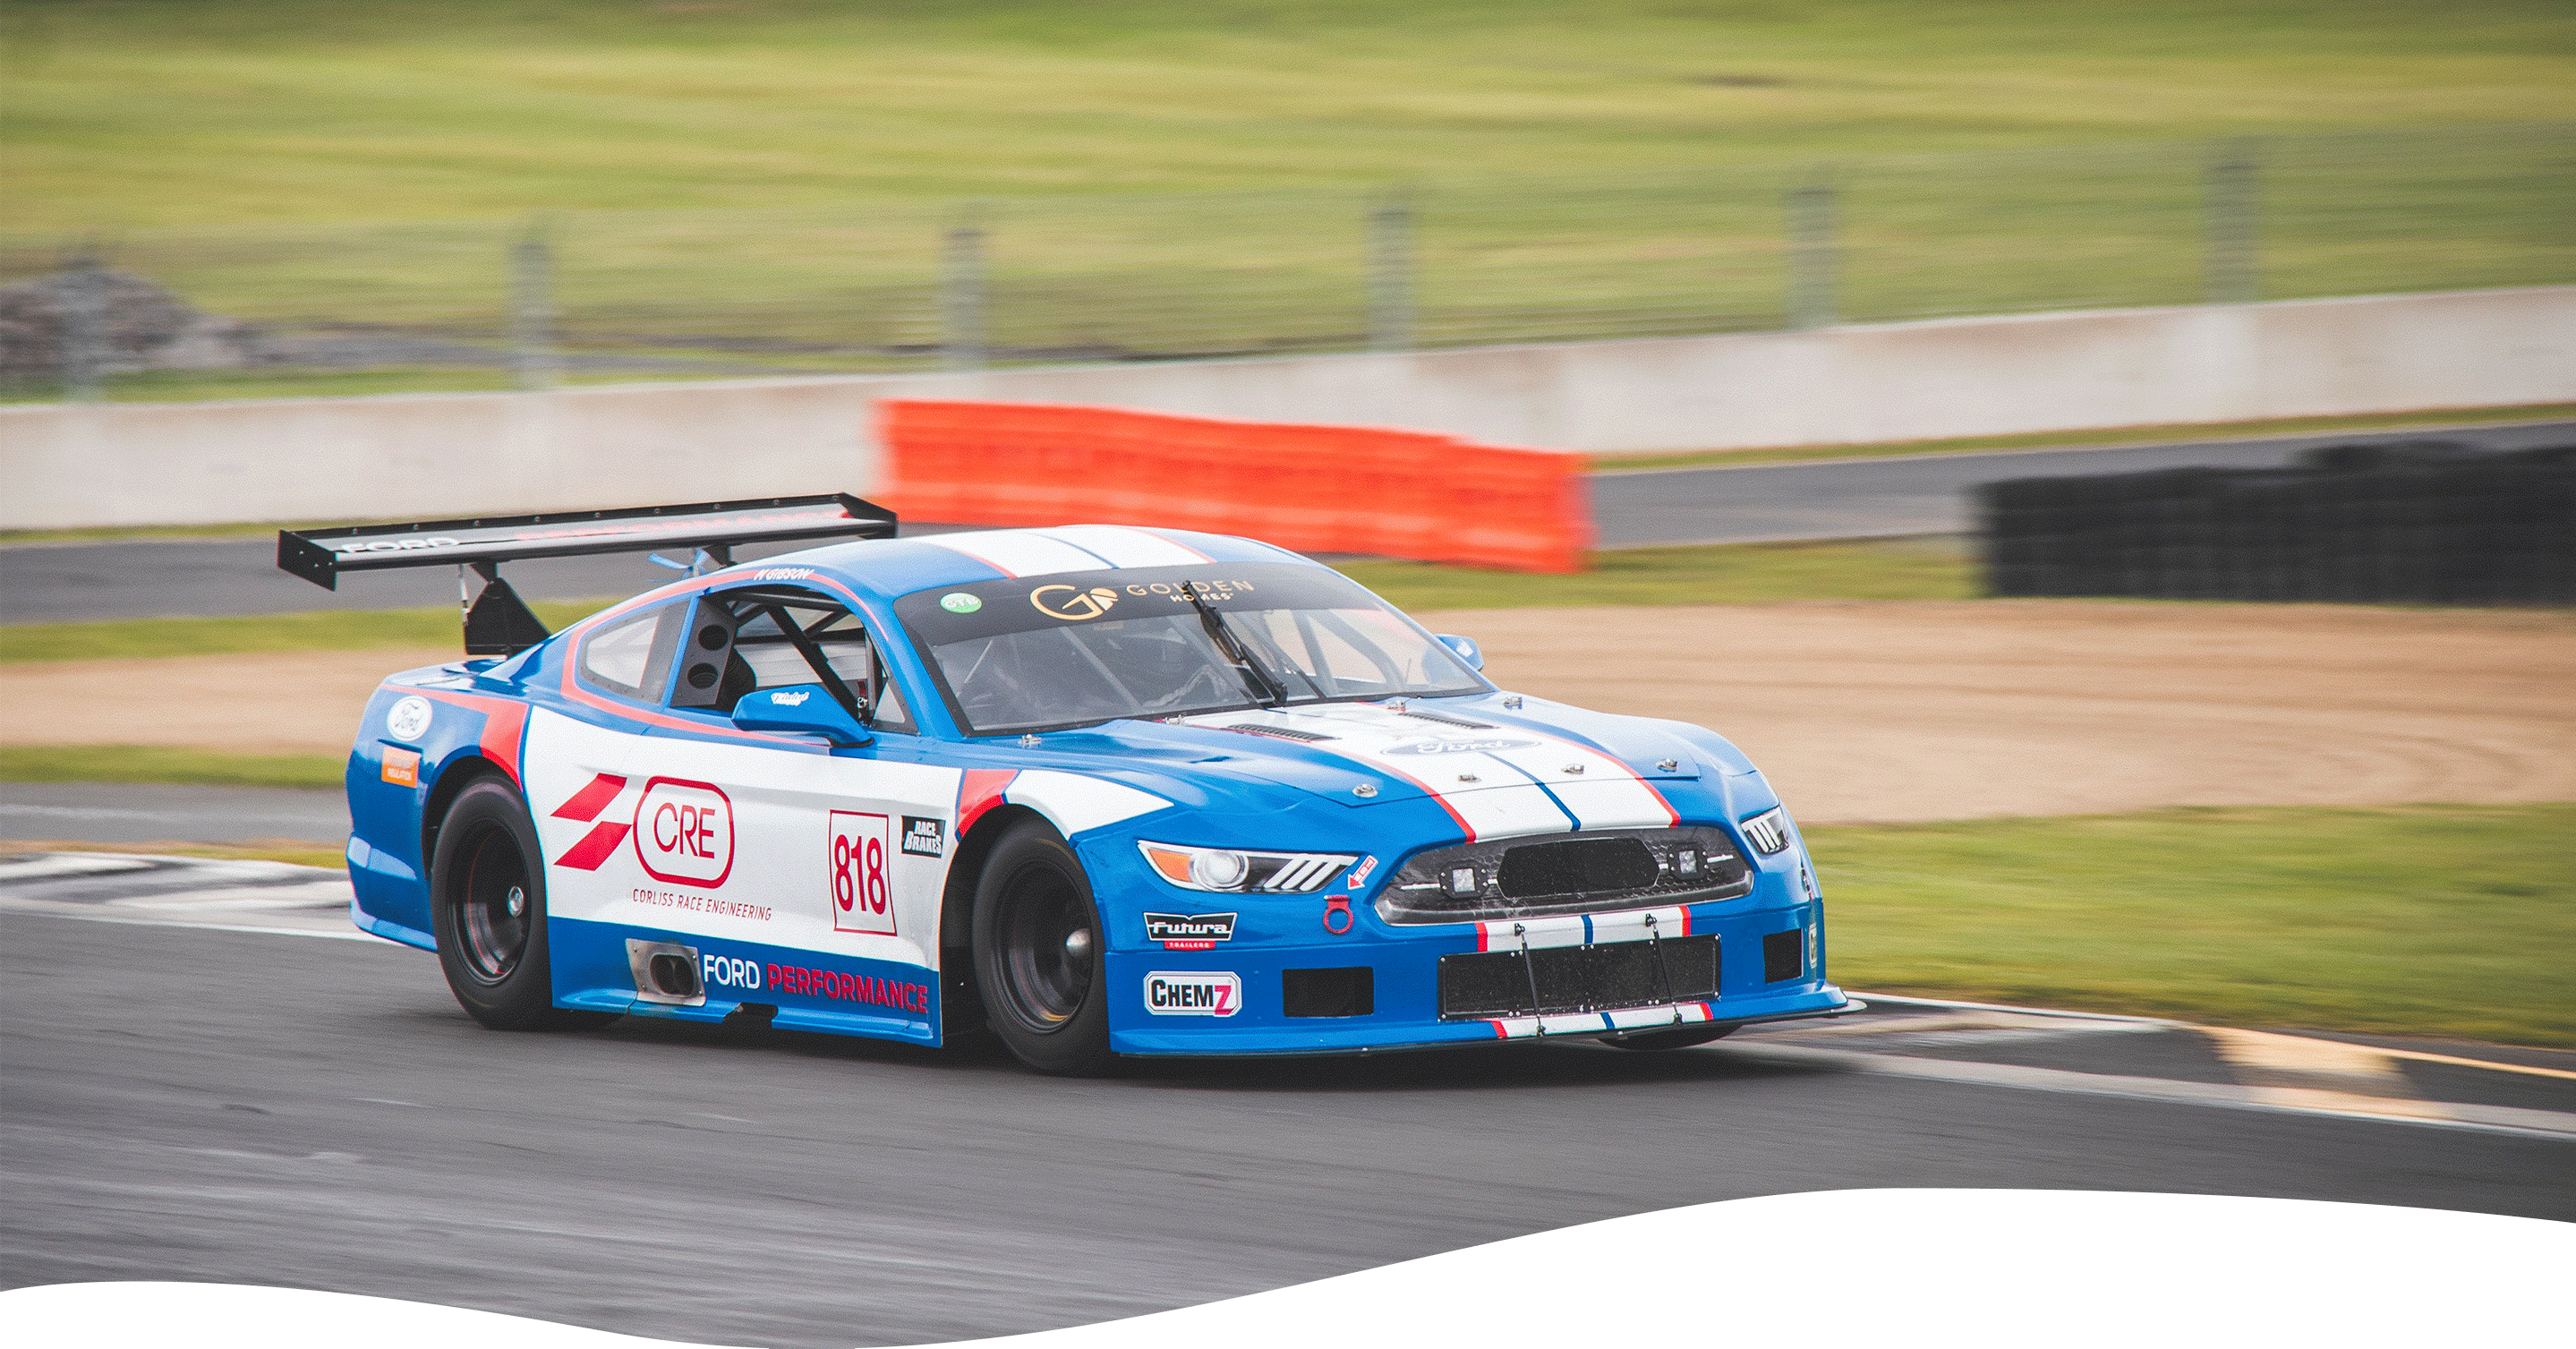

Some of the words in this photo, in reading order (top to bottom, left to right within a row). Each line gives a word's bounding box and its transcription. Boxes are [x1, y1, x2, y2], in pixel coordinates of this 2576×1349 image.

[342, 537, 459, 553] FORD
[1127, 581, 1254, 595] GOLDEN
[1417, 739, 1511, 754] Ford
[653, 802, 715, 859] CRE
[903, 830, 942, 855] BRAKES
[914, 820, 936, 837] RACE
[834, 833, 886, 915] 818
[633, 888, 674, 907] CORLISS
[677, 894, 703, 911] RACE
[705, 899, 772, 921] ENGINEERING
[704, 954, 760, 989] FORD
[767, 963, 929, 1014] PERFORMANCE
[1151, 979, 1233, 1015] CHEMZ
